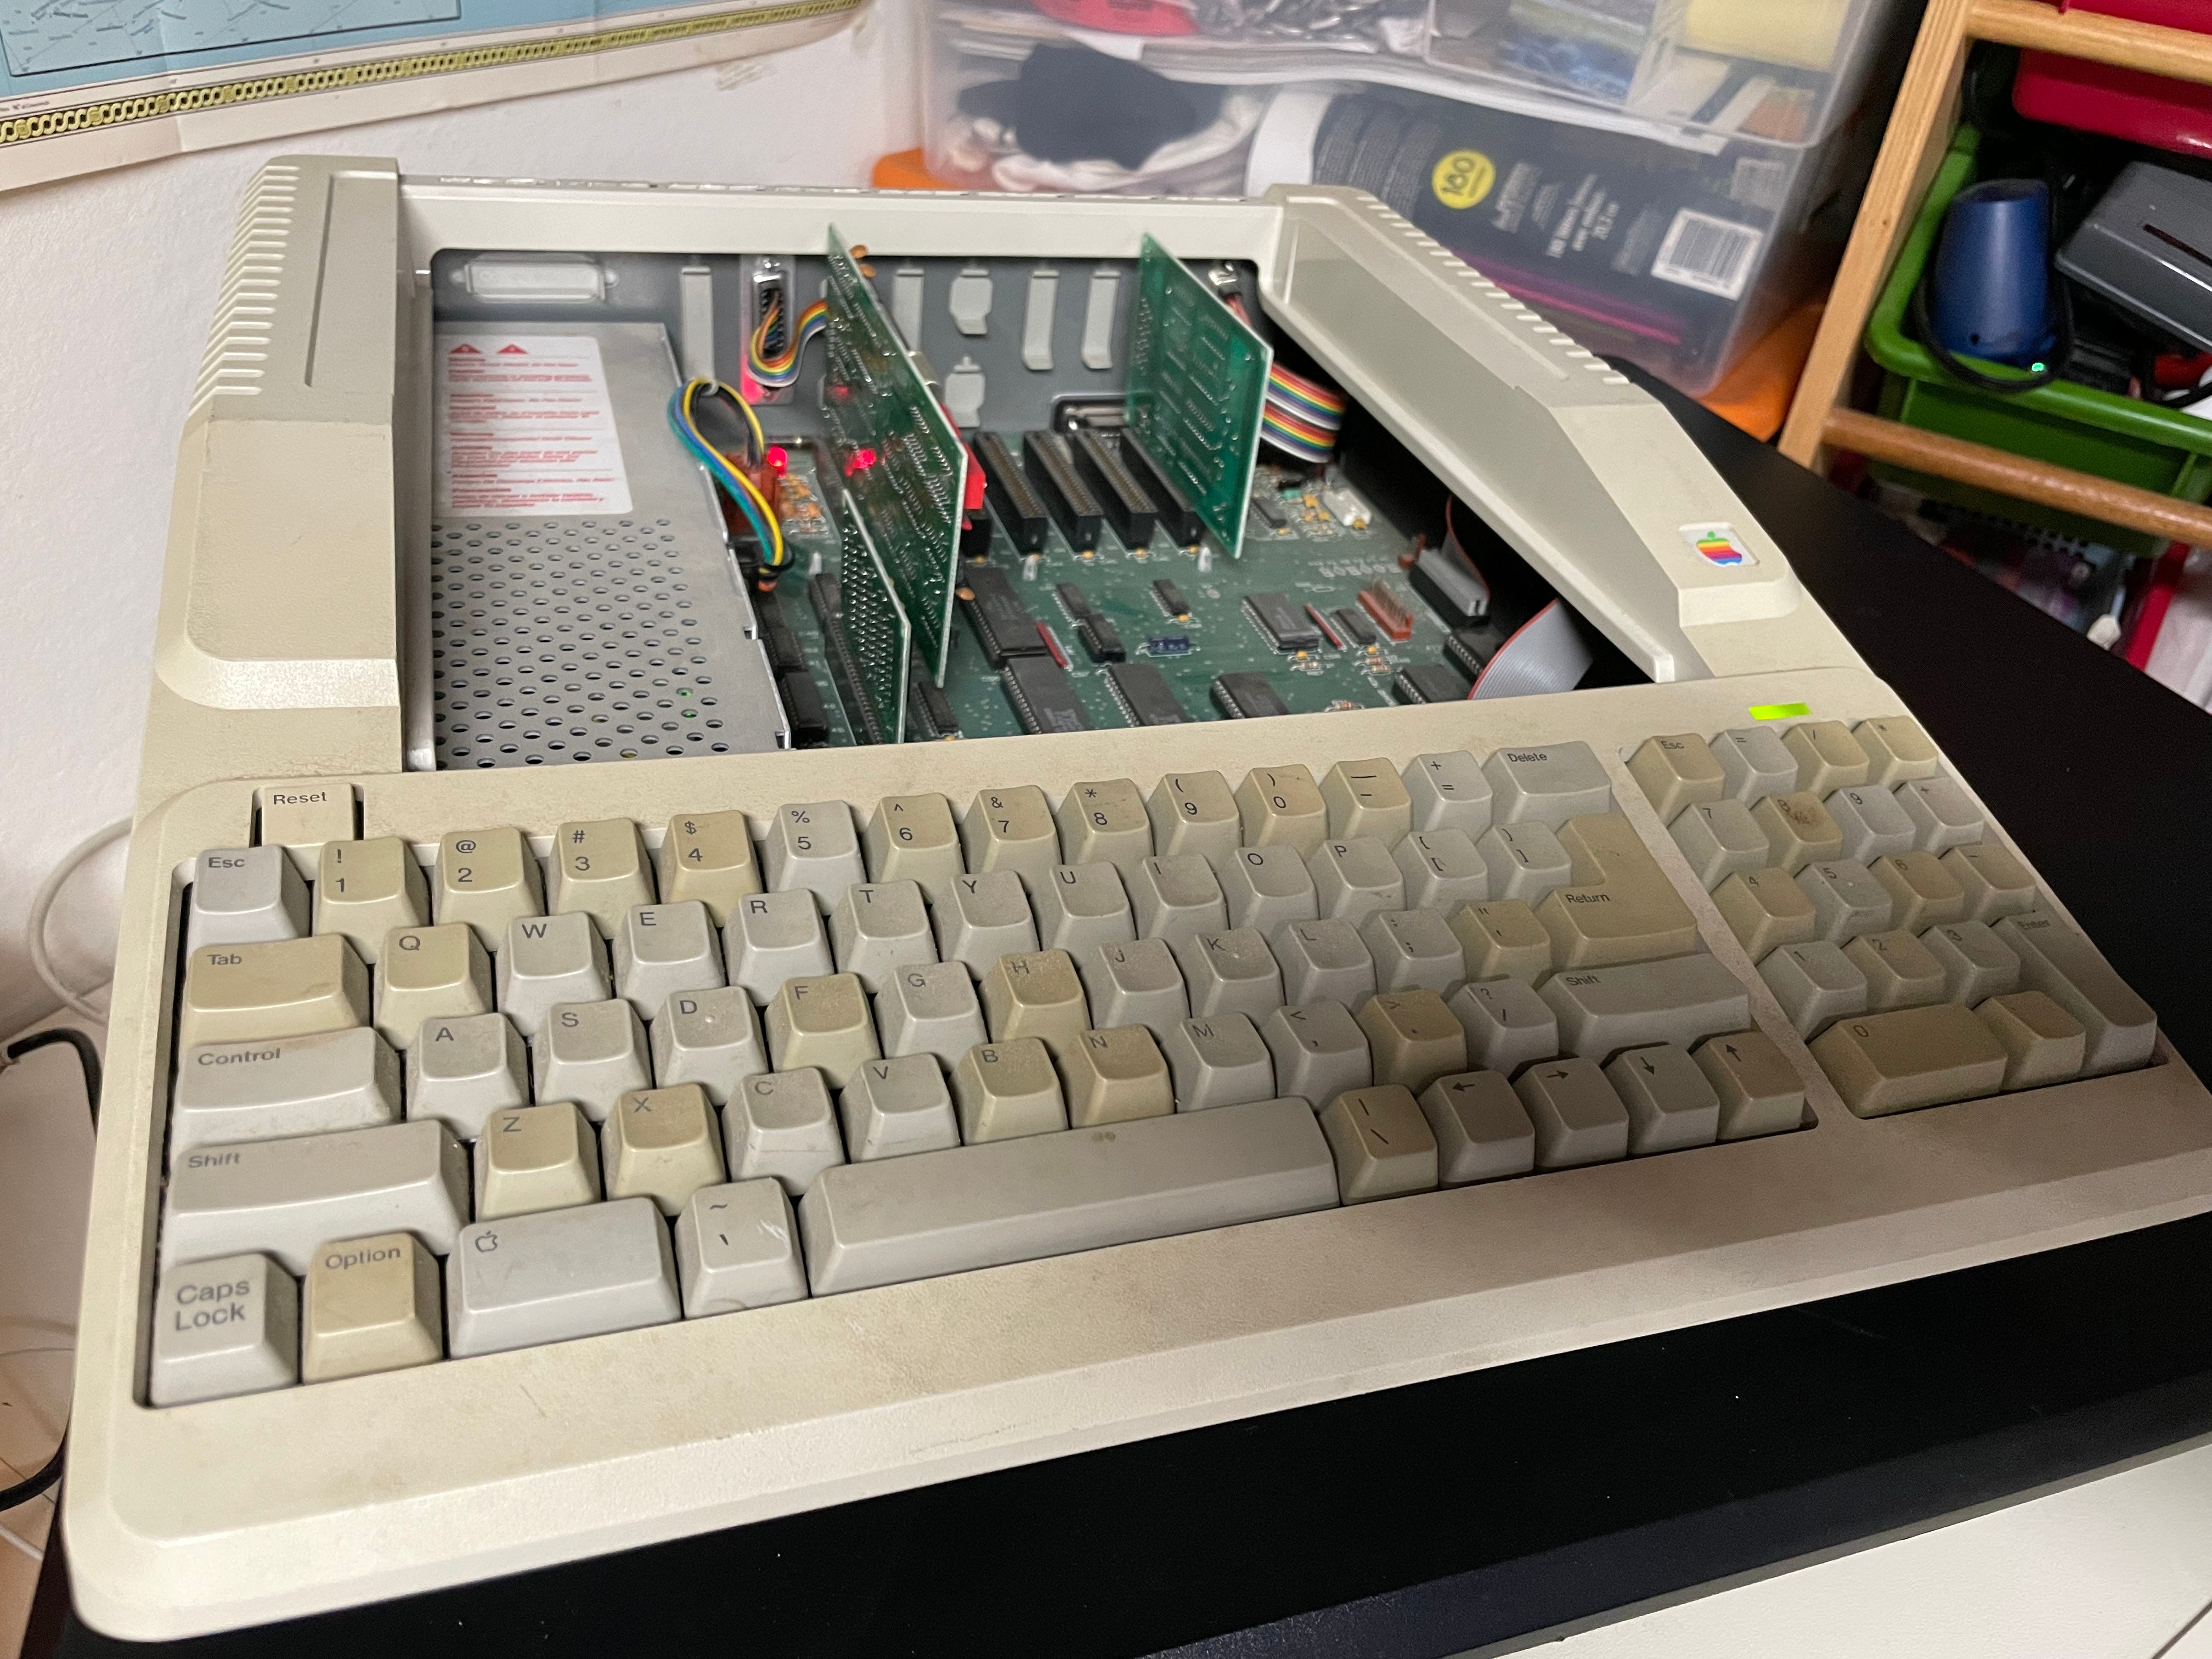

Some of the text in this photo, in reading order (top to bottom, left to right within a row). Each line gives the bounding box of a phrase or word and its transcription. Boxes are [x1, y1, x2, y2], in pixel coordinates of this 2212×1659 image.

[1661, 740, 1684, 749] Esc
[1507, 753, 1547, 762] Delete
[1431, 761, 1441, 770] +
[1176, 779, 1183, 792] (
[1267, 774, 1275, 786] )
[274, 792, 326, 805] Reset
[991, 797, 1003, 808] &
[1273, 797, 1286, 808] 0
[1850, 793, 1863, 804] 9
[1185, 803, 1197, 815] 9
[1702, 808, 1712, 819] 7
[791, 811, 810, 823] %
[1094, 812, 1107, 825] 8
[685, 821, 697, 834] $
[998, 821, 1009, 833] 7
[573, 830, 585, 843] #
[899, 828, 912, 840] 6
[456, 840, 476, 853] @
[798, 837, 811, 850] 5
[337, 849, 341, 863] !
[689, 848, 703, 862] 4
[1334, 845, 1346, 857] P
[208, 857, 244, 868] Esc
[575, 856, 590, 871] 3
[1248, 853, 1263, 865] O
[1431, 857, 1443, 871] [
[1895, 859, 1908, 870] 6
[1154, 862, 1161, 874] I
[1823, 868, 1837, 879] 5
[458, 868, 472, 882] 2
[1060, 871, 1076, 884] U
[1749, 876, 1759, 887] 4
[336, 878, 344, 892] 1
[962, 881, 977, 893] Y
[859, 890, 873, 903] T
[1565, 894, 1610, 903] Return
[751, 900, 768, 913] R
[640, 912, 656, 926] E
[2017, 920, 2050, 930] Enter
[522, 924, 547, 938] W
[1300, 929, 1316, 941] L
[1946, 930, 1962, 941] 3
[399, 936, 420, 951] Q
[1206, 938, 1225, 950] K
[1406, 943, 1414, 952] ;
[1872, 939, 1887, 951] 2
[207, 954, 242, 965] Tab
[1115, 950, 1125, 962] J
[1794, 951, 1805, 962] 1
[1011, 961, 1030, 974] H
[907, 973, 926, 987] G
[1566, 975, 1601, 985] Shift
[794, 986, 808, 1000] F
[1481, 989, 1492, 999] ?
[680, 1000, 697, 1014] D
[1386, 1001, 1400, 1009] >
[562, 1012, 579, 1027] S
[1290, 1011, 1306, 1020] <
[436, 1028, 454, 1041] A
[1192, 1024, 1214, 1037] M
[1853, 1025, 1869, 1037] 0
[1088, 1036, 1107, 1048] N
[198, 1048, 280, 1065] Control
[981, 1049, 998, 1063] B
[873, 1066, 888, 1079] V
[755, 1081, 774, 1095] C
[633, 1097, 651, 1113] X
[503, 1117, 521, 1132] Z
[1370, 1129, 1389, 1144] \
[188, 1153, 240, 1168] Shift
[325, 1248, 400, 1269] Option
[177, 1279, 250, 1305] Caps
[174, 1302, 245, 1331] Lock
